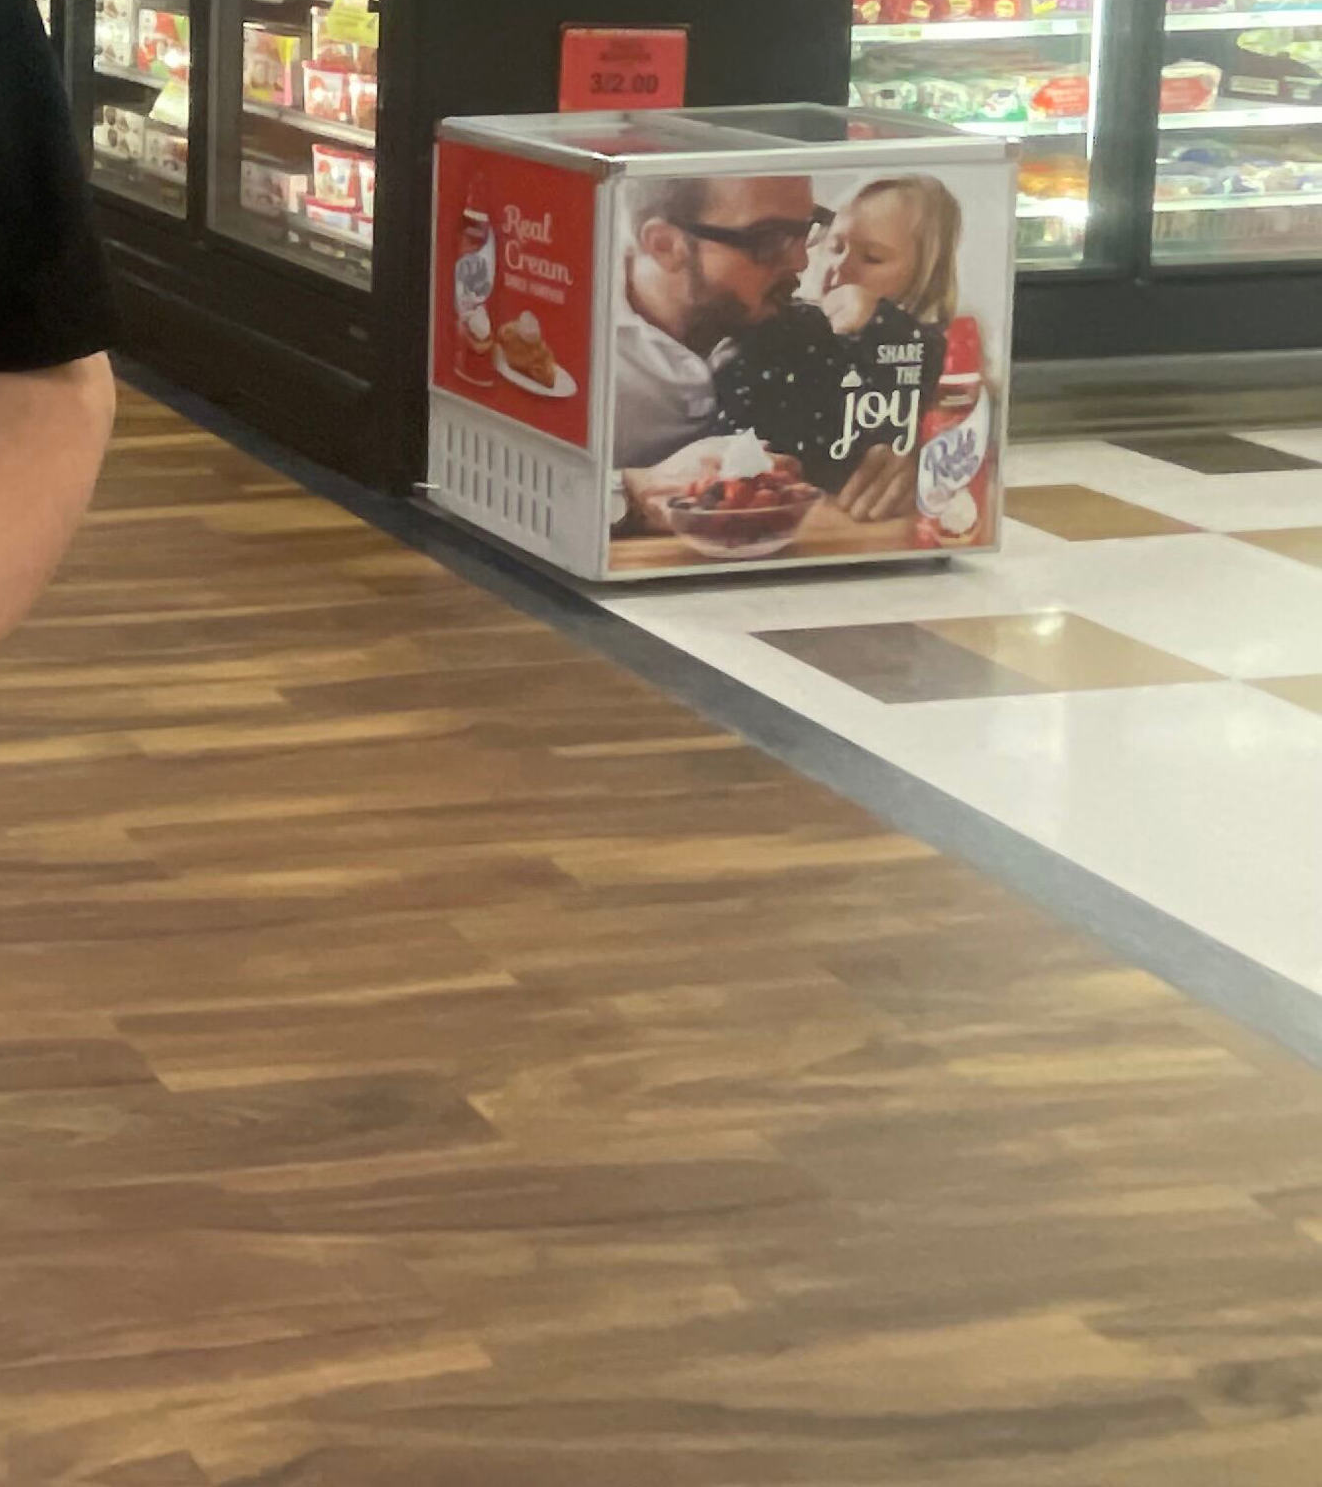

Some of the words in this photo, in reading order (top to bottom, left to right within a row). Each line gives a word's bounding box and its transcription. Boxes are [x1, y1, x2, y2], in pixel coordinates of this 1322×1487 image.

[502, 204, 553, 245] Real
[504, 240, 574, 286] Cream
[876, 342, 925, 365] SHARE
[895, 365, 923, 386] THE
[829, 384, 921, 461] joy
